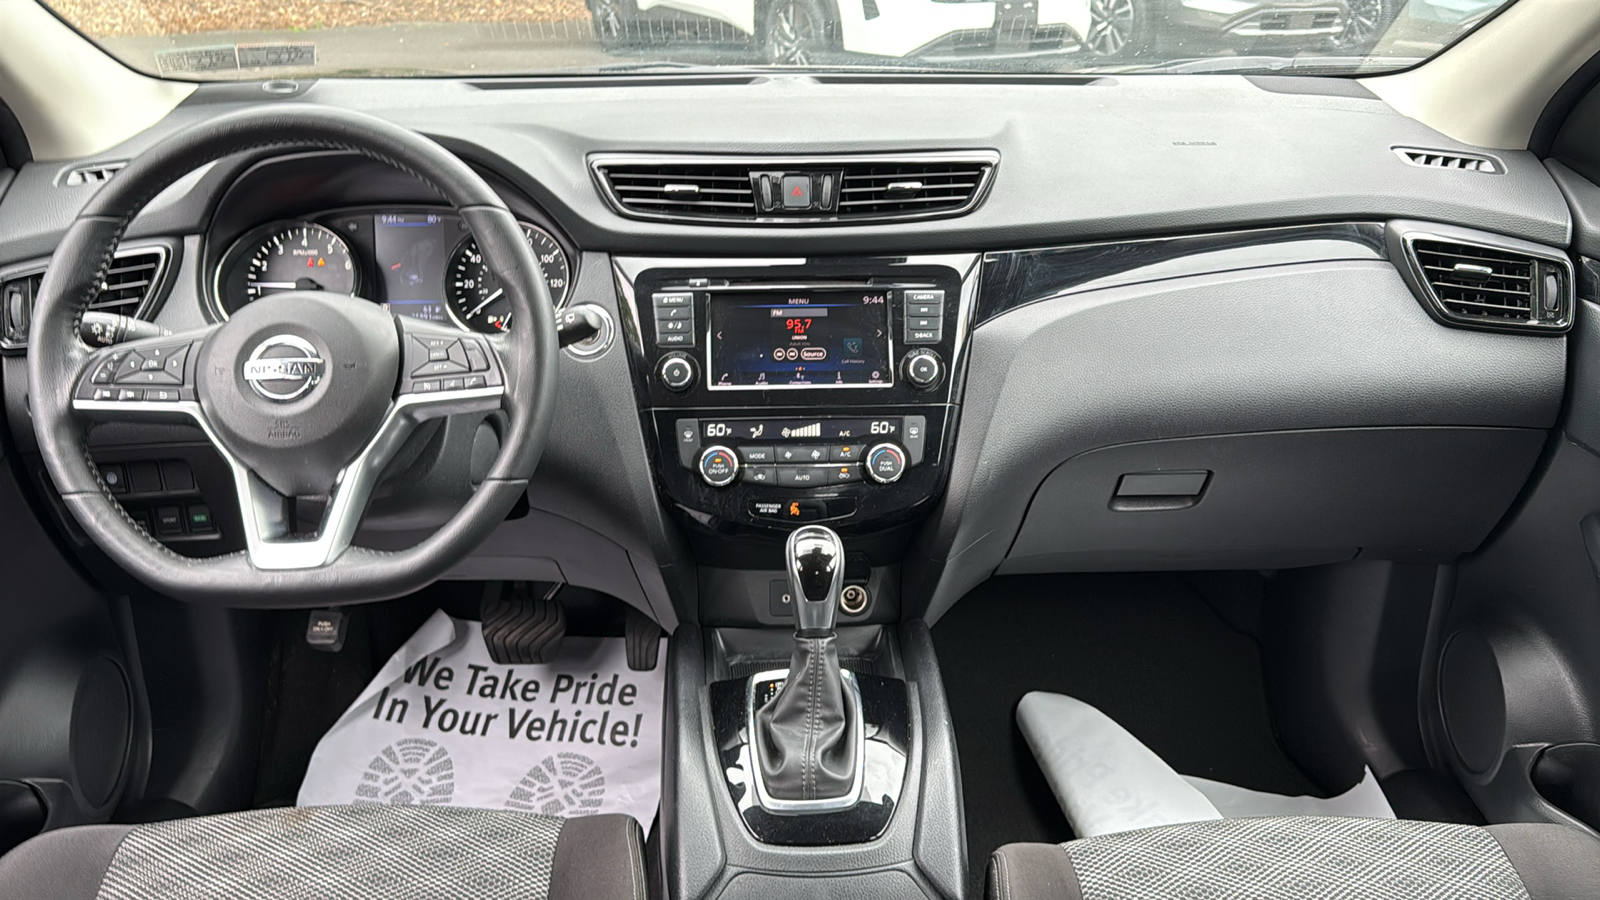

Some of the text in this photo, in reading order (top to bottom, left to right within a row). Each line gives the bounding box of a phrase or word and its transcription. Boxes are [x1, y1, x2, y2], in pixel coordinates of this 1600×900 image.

[278, 243, 284, 255] 3
[327, 243, 334, 254] 5
[470, 253, 482, 264] 40
[541, 254, 554, 263] 100
[261, 260, 268, 272] 2
[463, 279, 475, 289] 20
[550, 279, 563, 288] 120
[862, 295, 885, 305] 9:44
[785, 318, 813, 330] 95.7
[404, 654, 637, 706] We Take Pride
[373, 686, 643, 748] In Your Vehicle!
